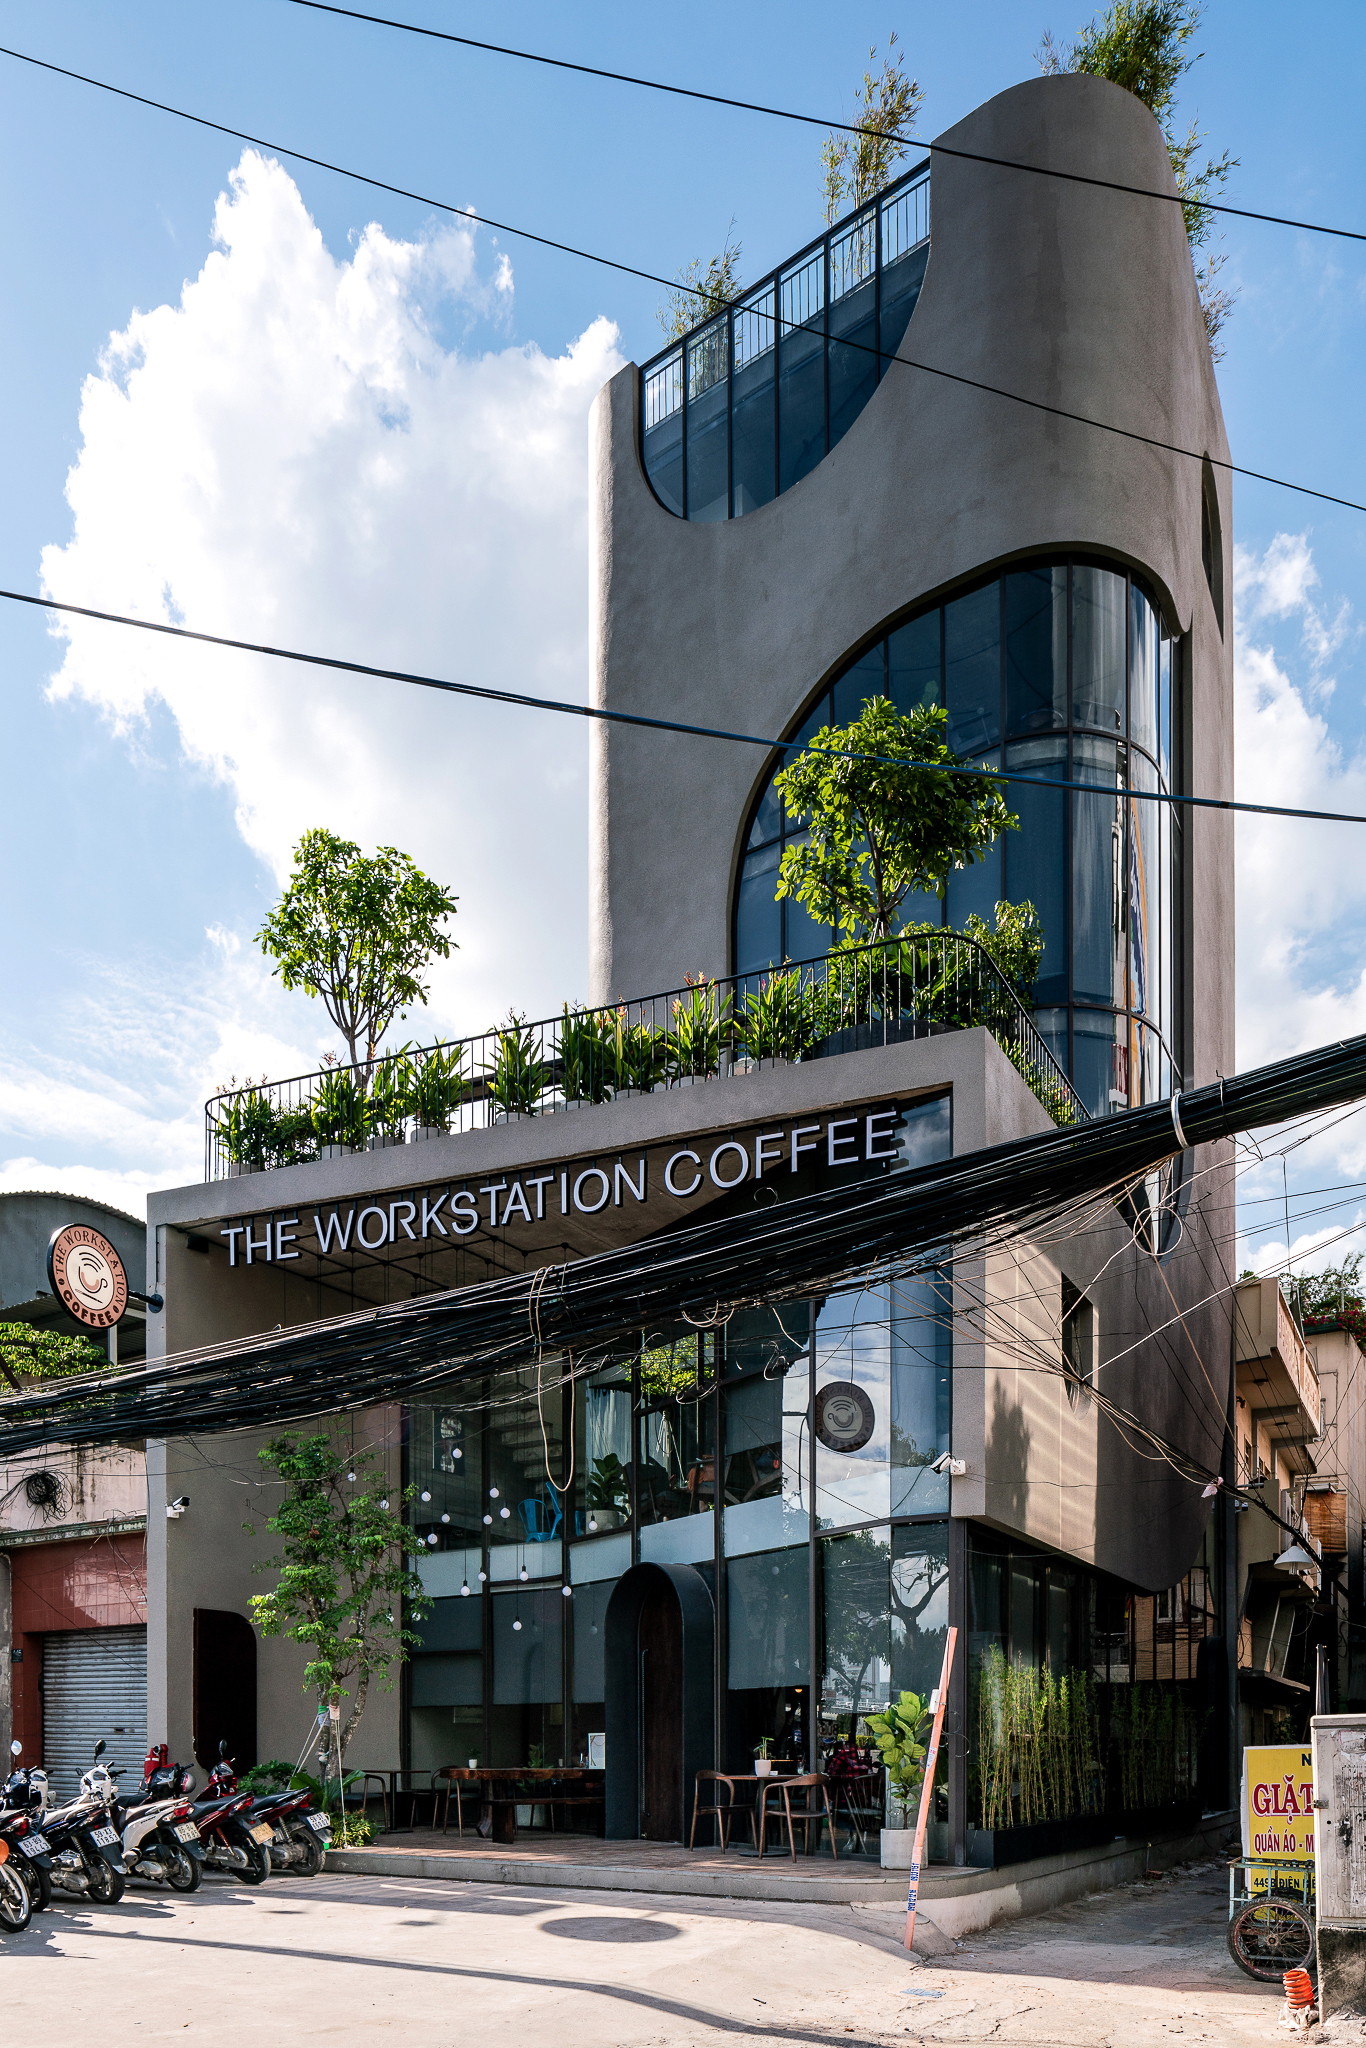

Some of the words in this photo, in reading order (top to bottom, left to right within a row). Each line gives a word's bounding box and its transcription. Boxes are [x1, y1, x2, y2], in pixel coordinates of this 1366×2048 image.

[220, 1219, 300, 1266] THE
[313, 1160, 645, 1254] WORKSTATION
[664, 1110, 898, 1197] COFFEE
[55, 1244, 67, 1275] THE
[63, 1229, 125, 1307] WORKSTATION
[63, 1289, 115, 1326] COFFEE
[1254, 1826, 1280, 1855] QUẦN
[1283, 1829, 1296, 1853] ÁO
